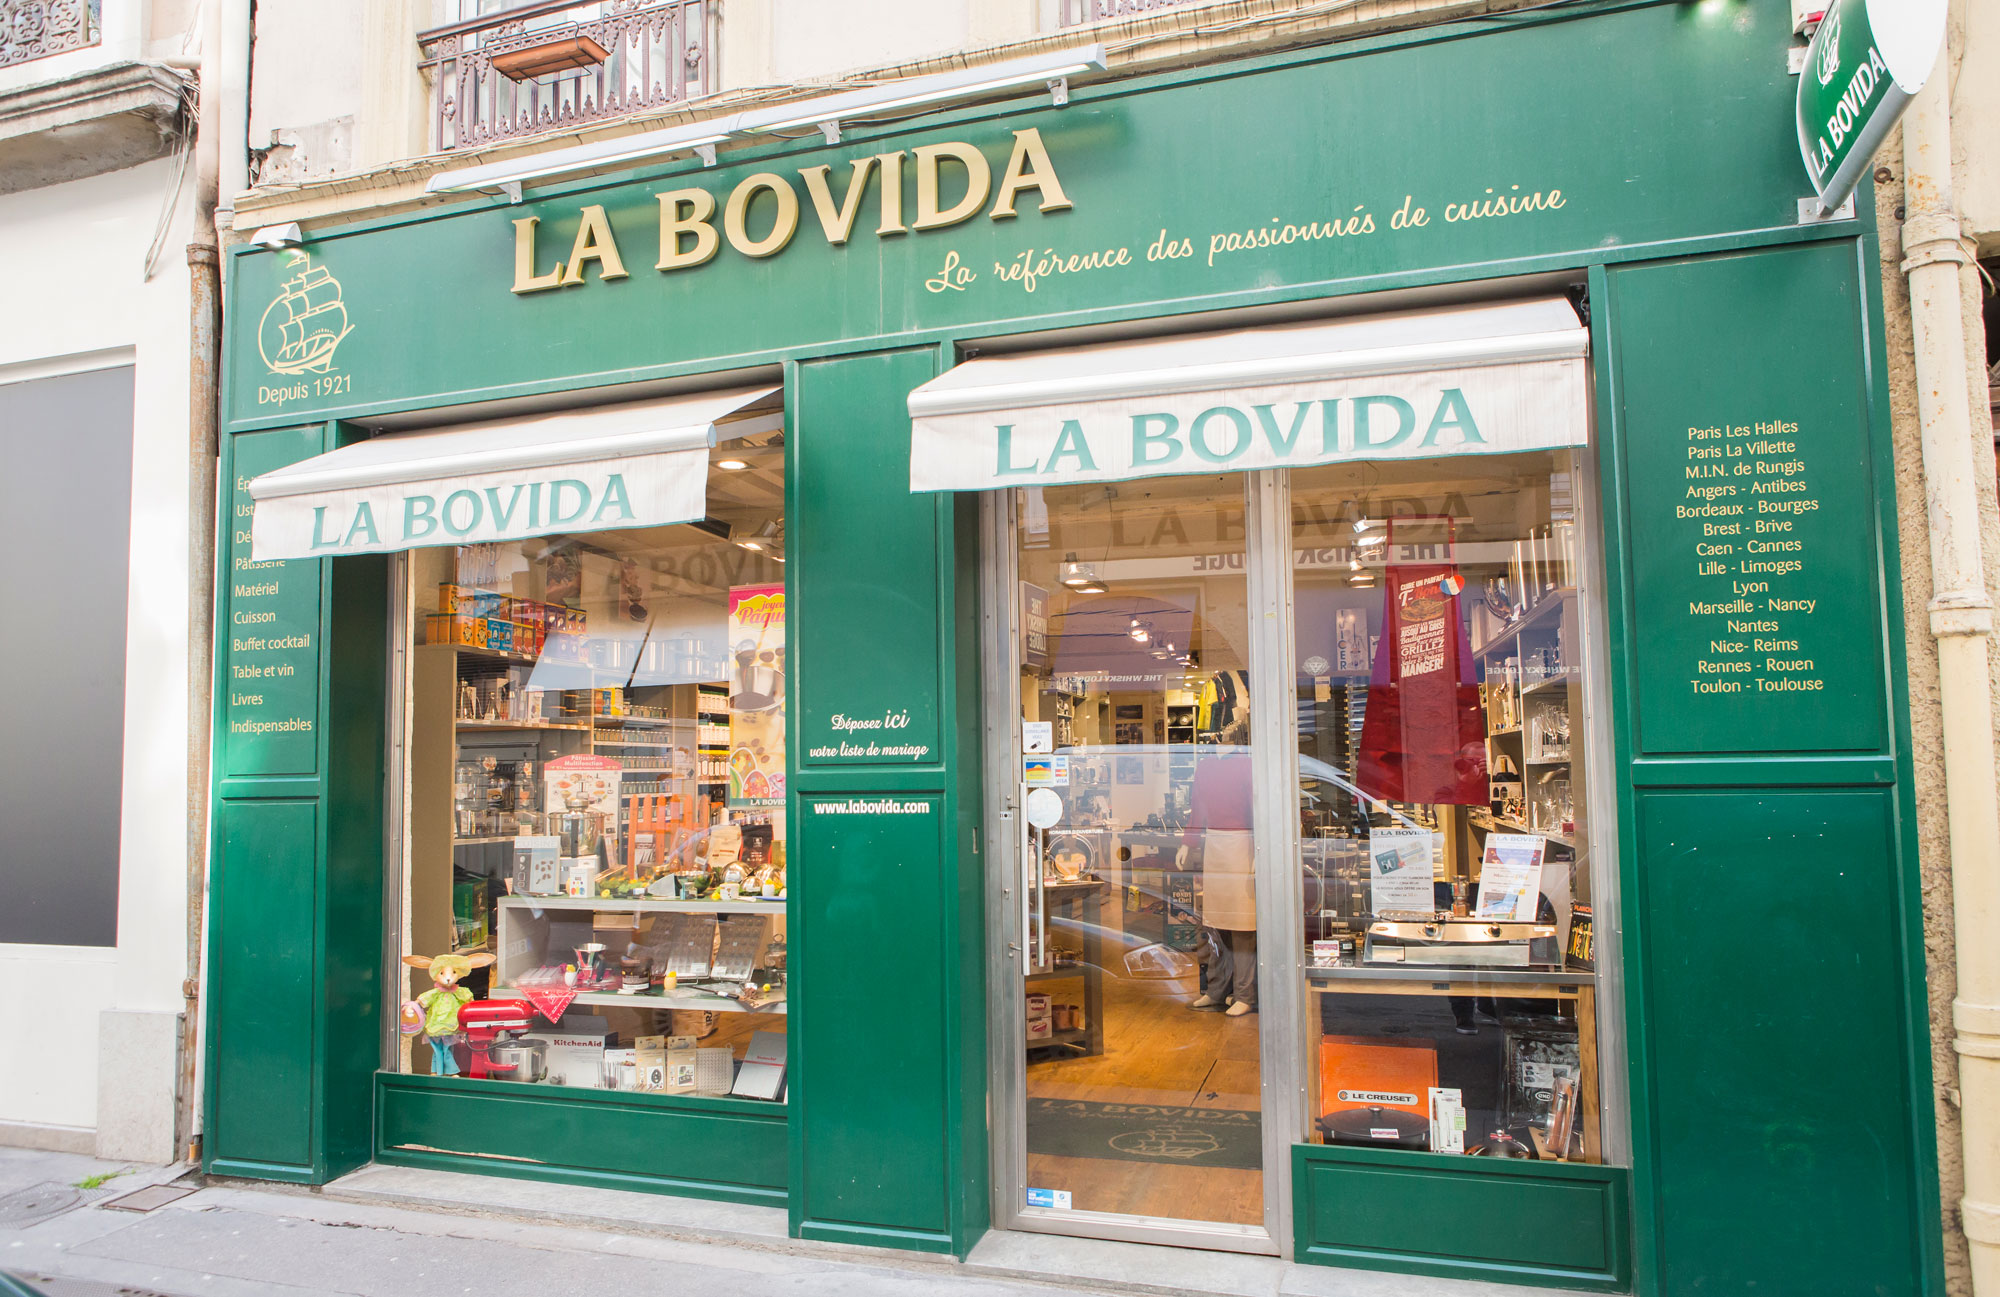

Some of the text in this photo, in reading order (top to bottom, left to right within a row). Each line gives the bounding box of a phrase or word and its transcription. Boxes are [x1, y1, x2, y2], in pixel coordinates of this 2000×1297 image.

[1811, 46, 1887, 179] LA BOVIDA
[510, 127, 1074, 296] LA BOVIDA
[925, 183, 1566, 292] La référence des passionnés de cuisine
[258, 374, 351, 407] Depuis 1921
[992, 387, 1489, 477] LA BOVIDA
[1688, 420, 1799, 440] Paris Les Halles
[1688, 440, 1796, 459] Paris La Villette
[1685, 459, 1805, 479] M.I.N. de Rungis
[1686, 485, 1737, 501] Angers
[1751, 479, 1807, 495] Antibes
[309, 473, 637, 551] LA BOVIDA
[1676, 503, 1744, 519] Bordeaux
[1758, 499, 1819, 515] Bourges
[1703, 522, 1741, 536] Brest
[1755, 519, 1793, 534] Brive
[1696, 543, 1733, 556] Caen
[1747, 539, 1802, 553] Cannes
[1698, 561, 1727, 575] Lille
[1741, 559, 1802, 575] Limoges
[235, 581, 279, 598] Matériel
[1400, 574, 1446, 591] CUIRE UN PARFAIT
[1733, 580, 1769, 597] Lyon
[1689, 600, 1754, 615] Marseille
[1768, 598, 1816, 614] Nancy
[234, 611, 276, 625] Cuisson
[1728, 620, 1779, 633] Nantes
[233, 634, 310, 652] Buffet cocktail
[1401, 640, 1445, 657] GRILLEZ
[1754, 638, 1799, 652] Reims
[232, 664, 294, 679] Table et vin
[1401, 657, 1445, 678] MANGER!
[1698, 660, 1751, 673] Rennes
[1766, 658, 1814, 672] Rouen
[1691, 679, 1741, 693] Toulon
[1755, 677, 1824, 692] Toulouse
[232, 693, 263, 706] Livres
[231, 717, 313, 735] Indispensables
[831, 709, 910, 735] Déposez ici
[809, 741, 929, 761] votre liste de mariage
[750, 798, 786, 806] LA BOVID
[814, 799, 930, 816] www.labovida.com
[553, 1039, 602, 1048] KitchenAid
[1366, 1094, 1412, 1102] CREUSET
[1102, 1104, 1250, 1121] BOVIDA
